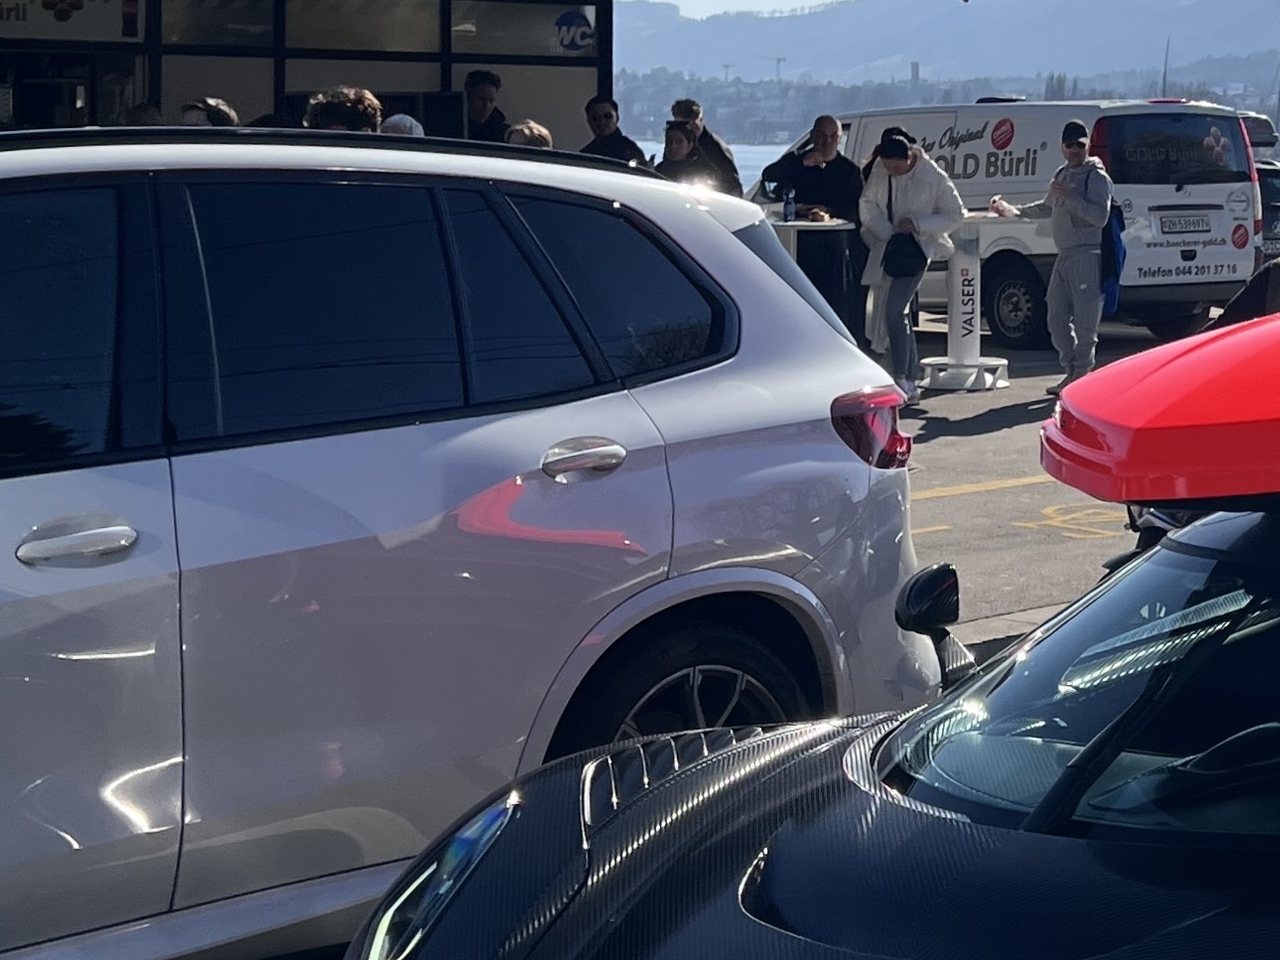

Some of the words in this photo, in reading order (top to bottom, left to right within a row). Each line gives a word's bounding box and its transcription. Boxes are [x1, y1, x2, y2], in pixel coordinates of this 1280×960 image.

[555, 26, 593, 46] WC
[933, 153, 980, 180] OLD
[985, 148, 1038, 179] Bürli
[1137, 266, 1173, 278] Telefon
[1174, 266, 1194, 277] 044
[1195, 265, 1211, 276] 201
[1214, 264, 1225, 275] 37
[1227, 263, 1238, 274] 16
[961, 277, 975, 338] VALSER
